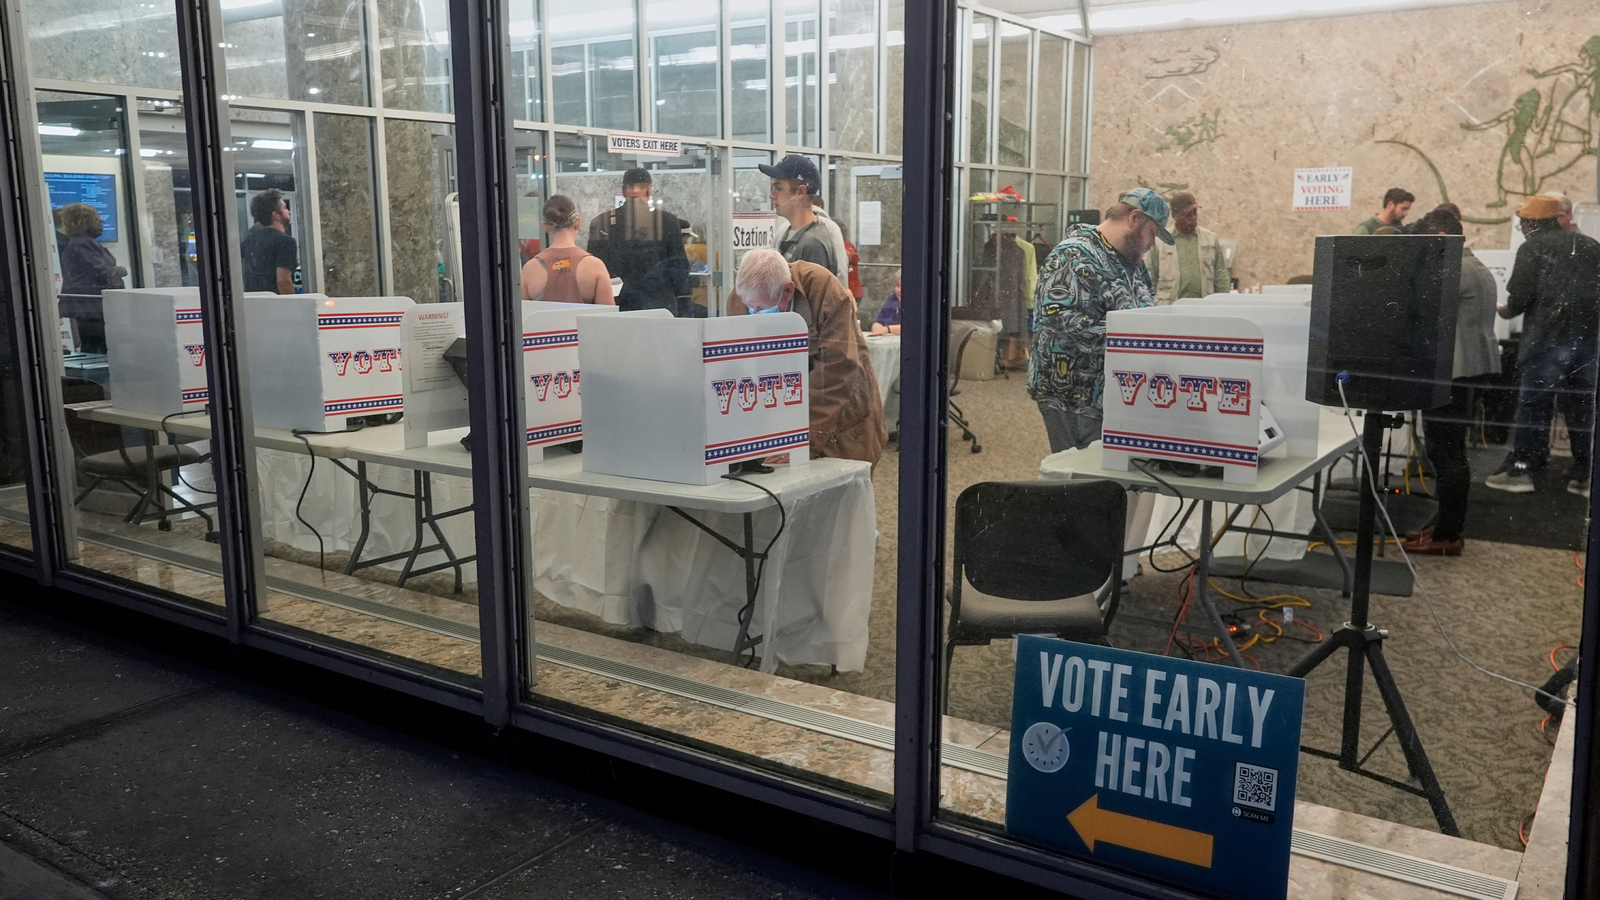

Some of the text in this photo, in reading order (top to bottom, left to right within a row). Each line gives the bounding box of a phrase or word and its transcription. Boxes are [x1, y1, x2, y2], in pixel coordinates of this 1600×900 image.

[612, 137, 678, 151] VOTERS EXIT HERE
[1307, 174, 1339, 183] EARLY
[1301, 185, 1344, 194] VOTING
[1305, 195, 1339, 205] HERE
[733, 226, 767, 247] Station
[418, 312, 449, 320] WARNING!
[327, 347, 402, 377] VOT
[711, 371, 803, 415] VOTE
[1112, 369, 1252, 416] VOTE
[1040, 651, 1275, 749] VOTE EARLY
[1095, 730, 1196, 808] HERE
[1243, 811, 1259, 820] SCAN
